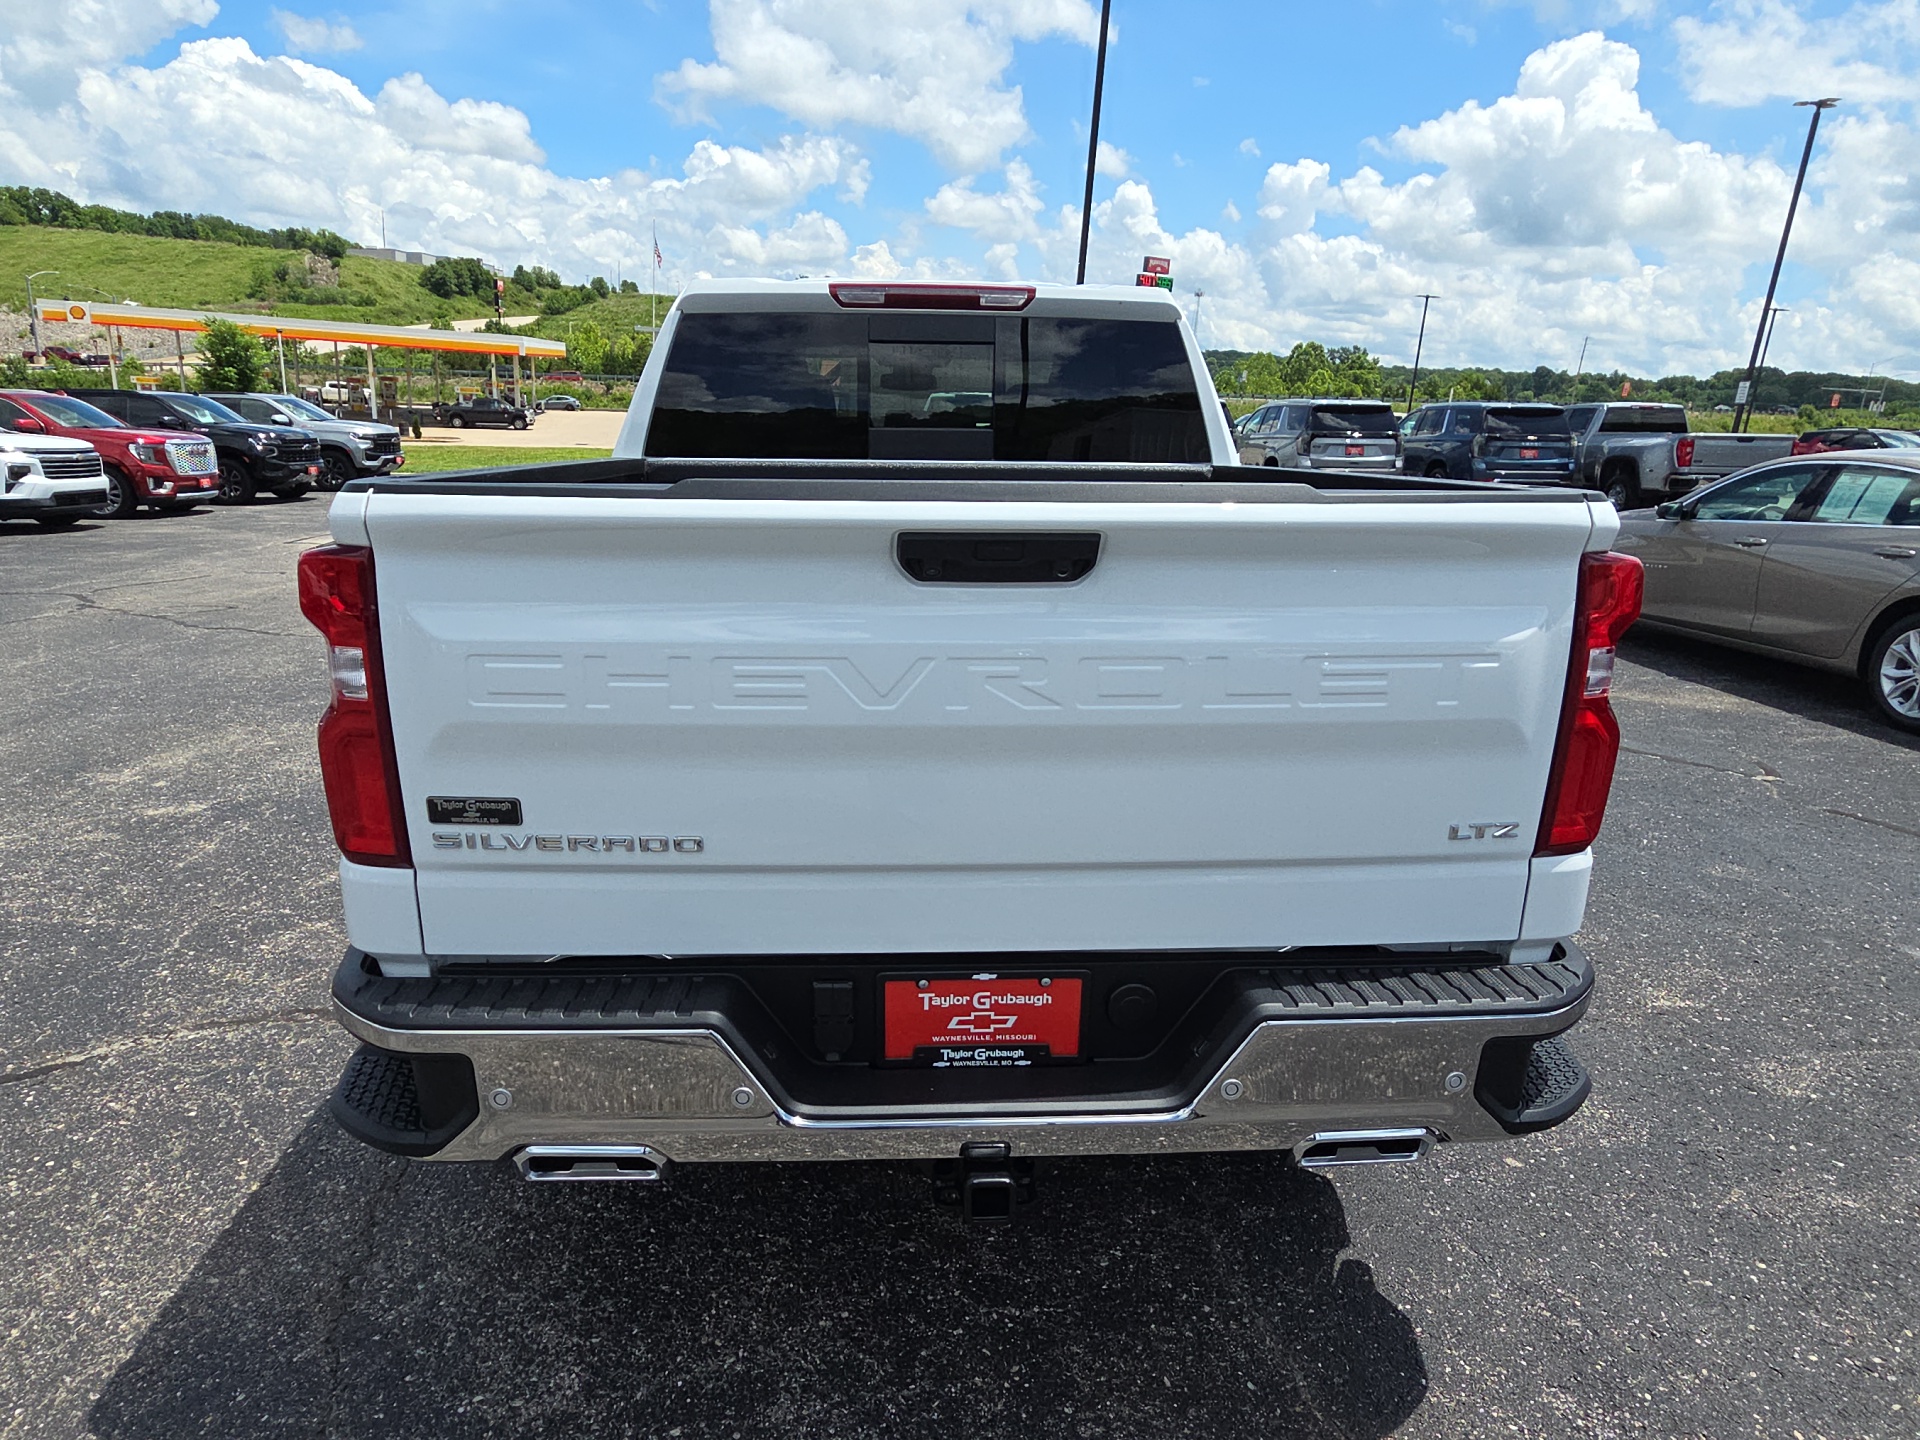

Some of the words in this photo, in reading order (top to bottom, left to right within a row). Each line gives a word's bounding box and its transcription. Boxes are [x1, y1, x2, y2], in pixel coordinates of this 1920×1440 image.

[464, 652, 1502, 711] CHEVROLET
[433, 799, 464, 812] Taylor
[465, 799, 512, 812] Grubaugh
[1448, 821, 1520, 840] LTZ
[432, 831, 704, 853] SILVERADO
[918, 992, 970, 1010] Taylor
[972, 991, 1052, 1009] Grubaugh
[932, 1034, 993, 1042] WAYNESVILLE,
[996, 1033, 1037, 1041] MISSOURI
[940, 1048, 973, 1061] Taylor
[974, 1048, 1024, 1060] Grubaugh
